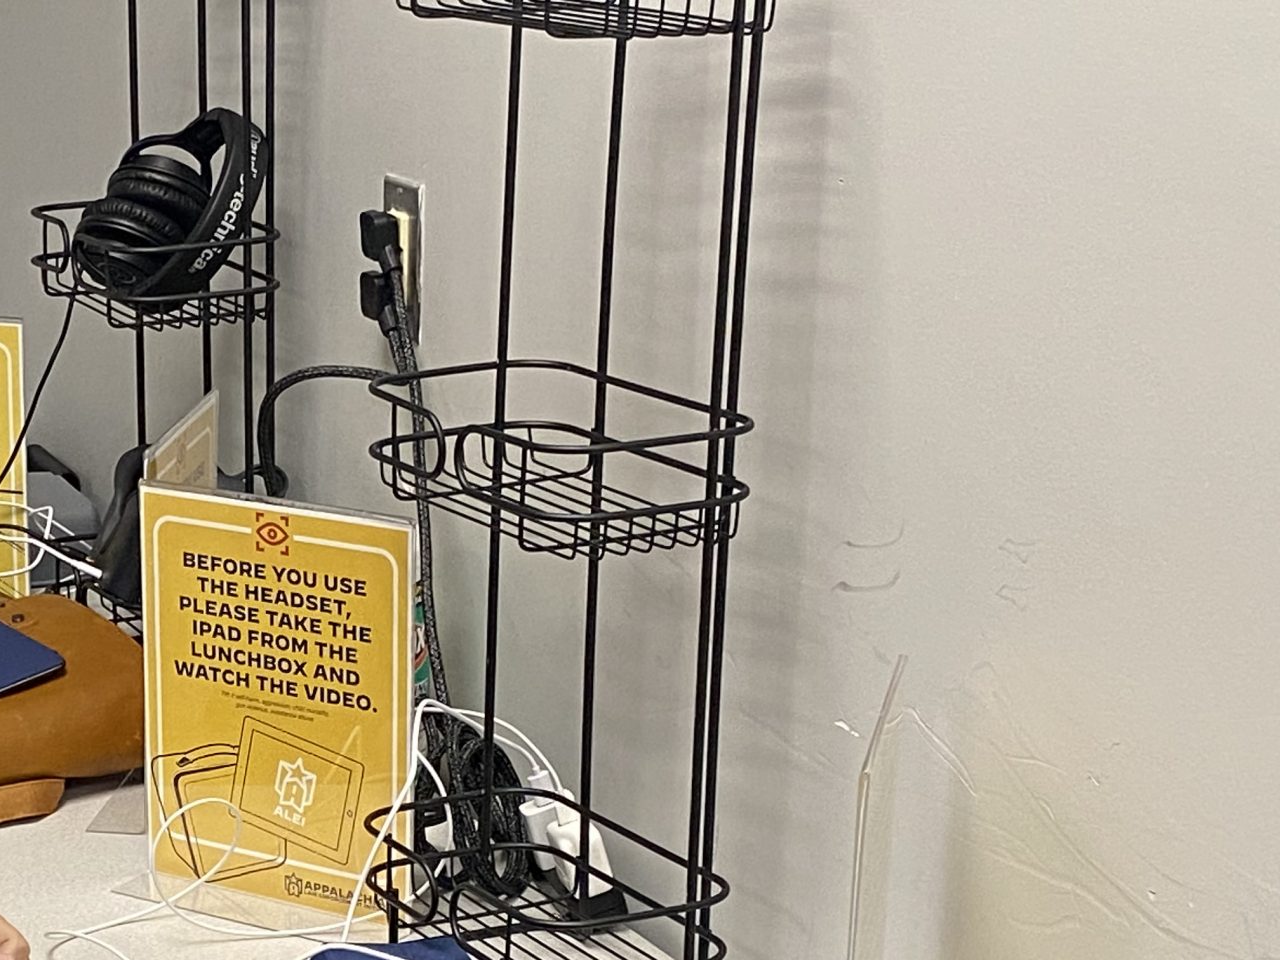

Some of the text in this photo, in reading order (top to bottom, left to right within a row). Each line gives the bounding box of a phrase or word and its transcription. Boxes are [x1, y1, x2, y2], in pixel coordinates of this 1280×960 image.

[183, 551, 368, 597] BEFORE YOU USE
[179, 595, 372, 643] PLEASE TAKE THE
[196, 576, 351, 620] THE HEADSET,
[191, 641, 360, 686] LUNCHBOX AND
[193, 619, 358, 664] IPAD FROM THE
[174, 659, 250, 688] WATCH
[256, 675, 298, 698] THE
[304, 684, 378, 713] VIDEO.
